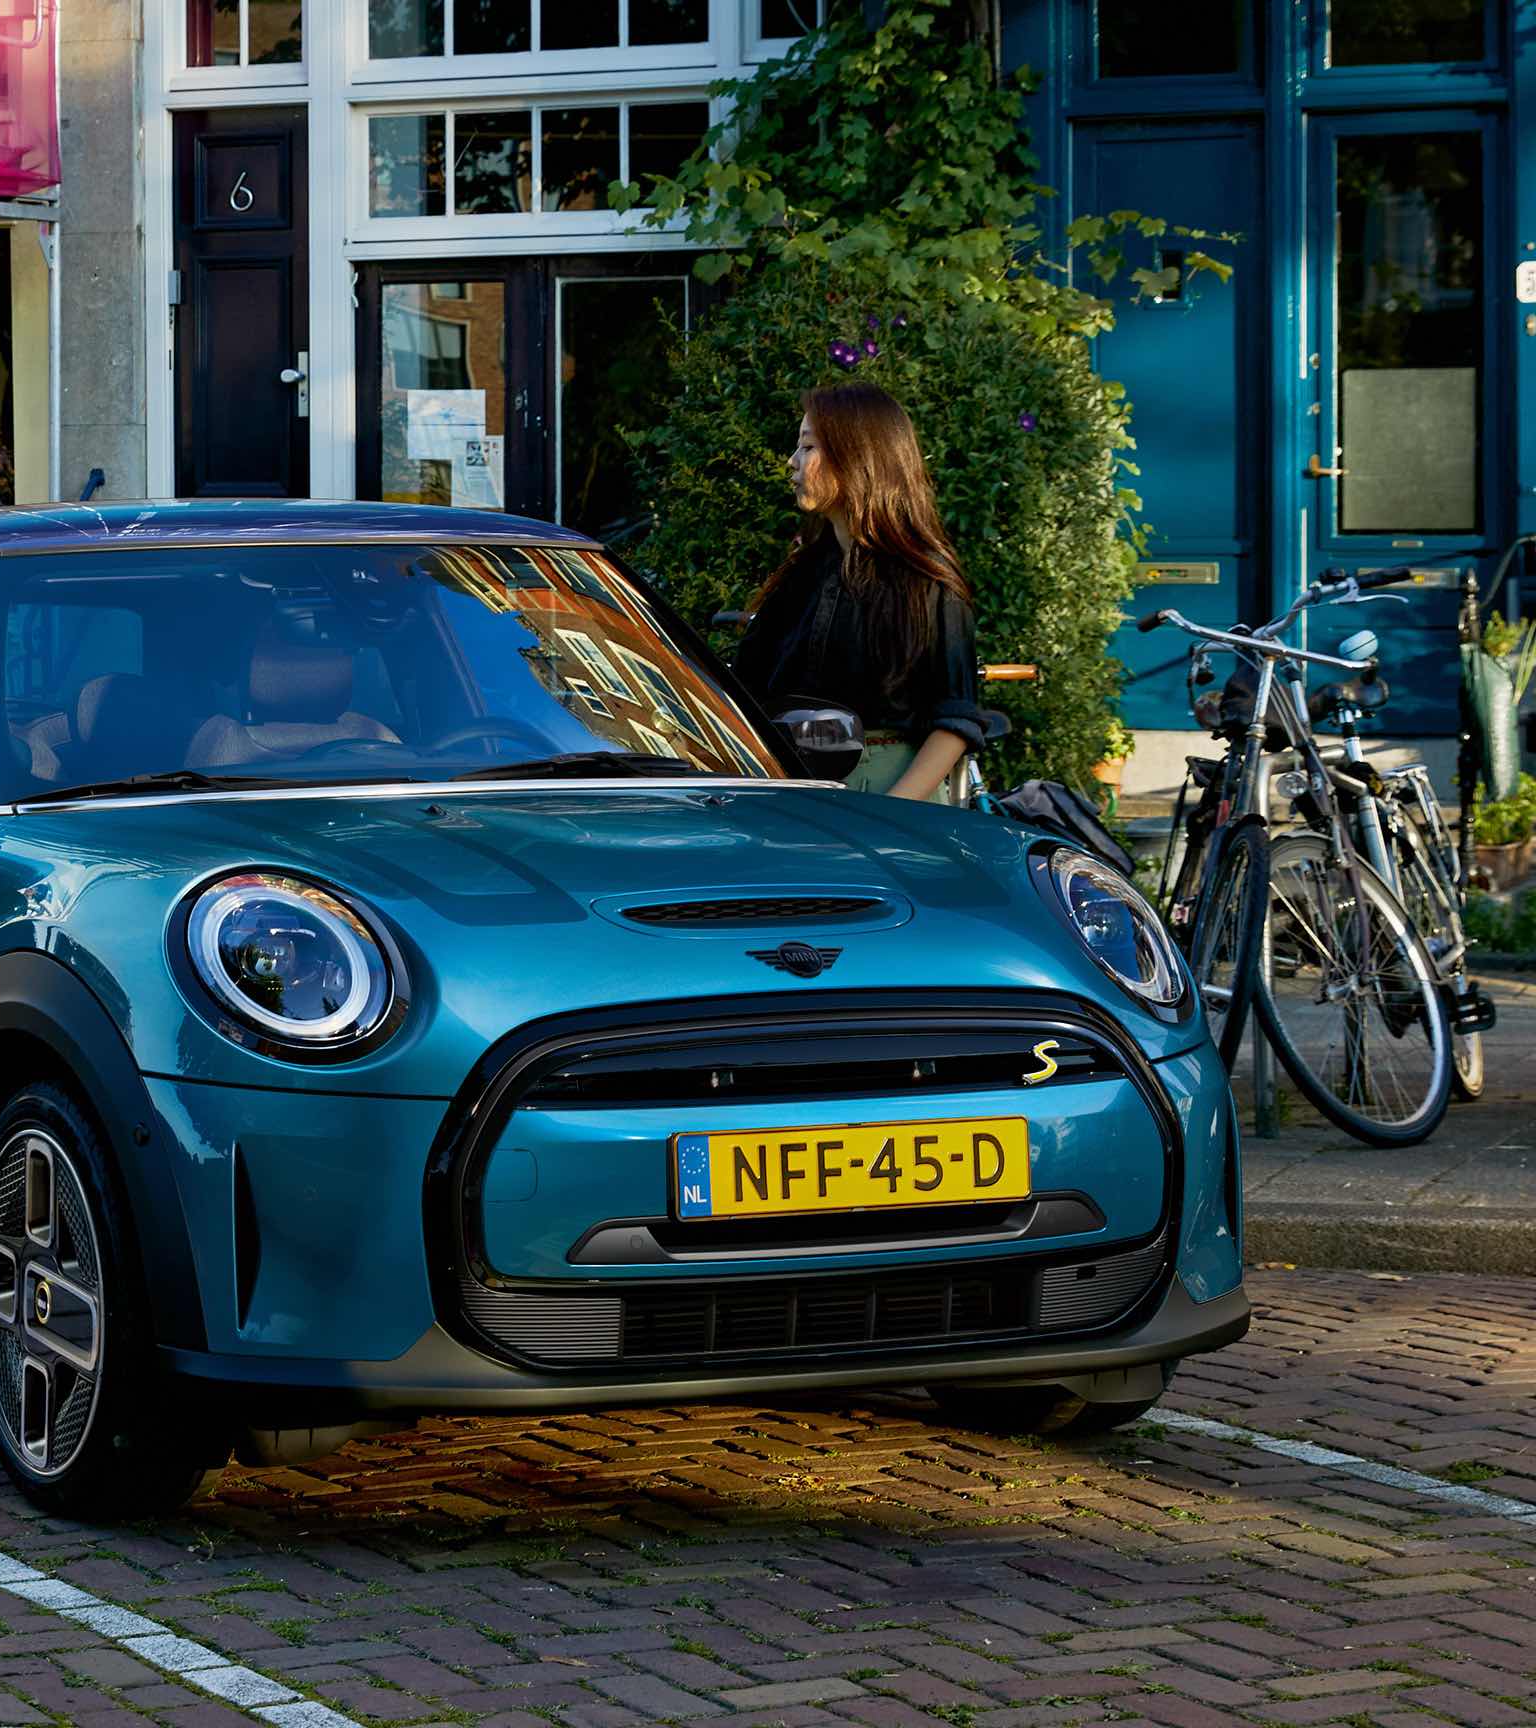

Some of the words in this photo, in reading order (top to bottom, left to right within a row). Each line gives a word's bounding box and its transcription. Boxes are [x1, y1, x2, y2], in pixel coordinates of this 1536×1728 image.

[230, 171, 253, 211] 6
[784, 951, 820, 962] MINI
[1022, 1040, 1060, 1084] S
[732, 1132, 1005, 1202] NFF-45-D
[684, 1184, 707, 1204] NL
